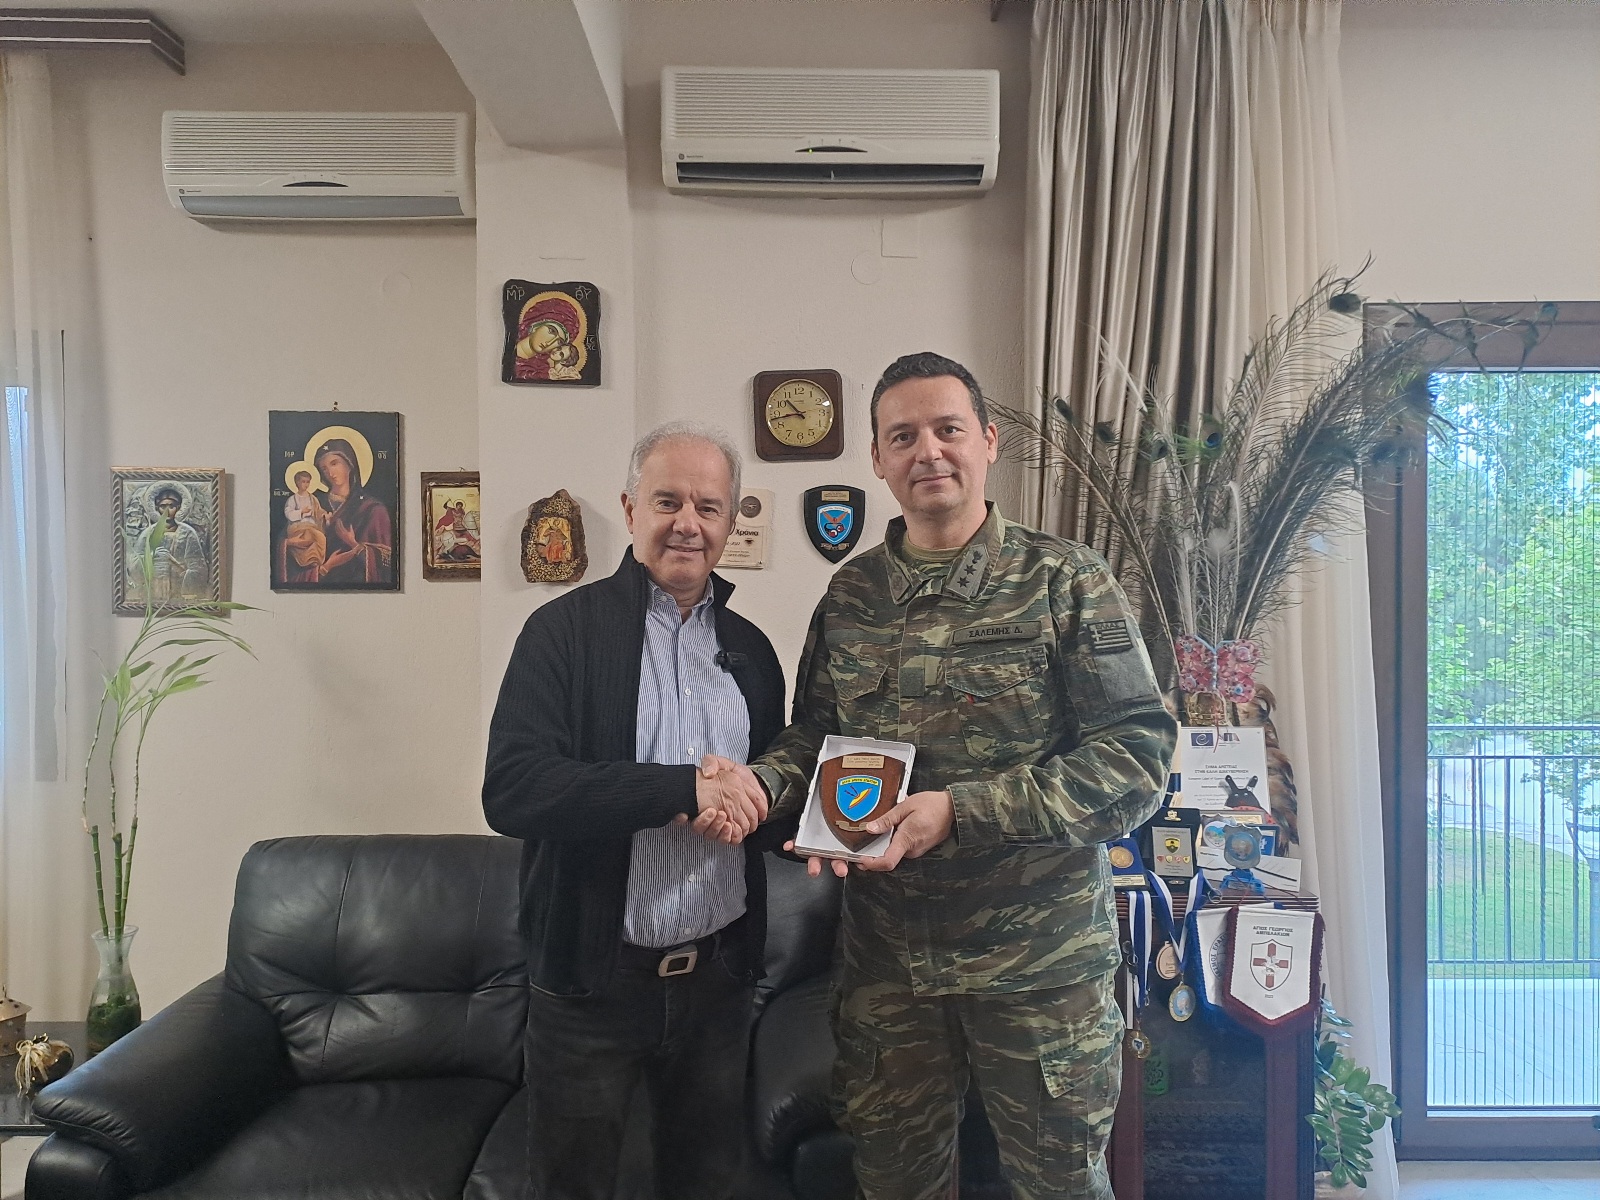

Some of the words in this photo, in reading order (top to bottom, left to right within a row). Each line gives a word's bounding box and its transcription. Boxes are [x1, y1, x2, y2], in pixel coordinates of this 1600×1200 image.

[794, 387, 804, 395] 12
[797, 432, 804, 440] 6
[968, 627, 1010, 638] ΣΑΛΕΜΗΣ
